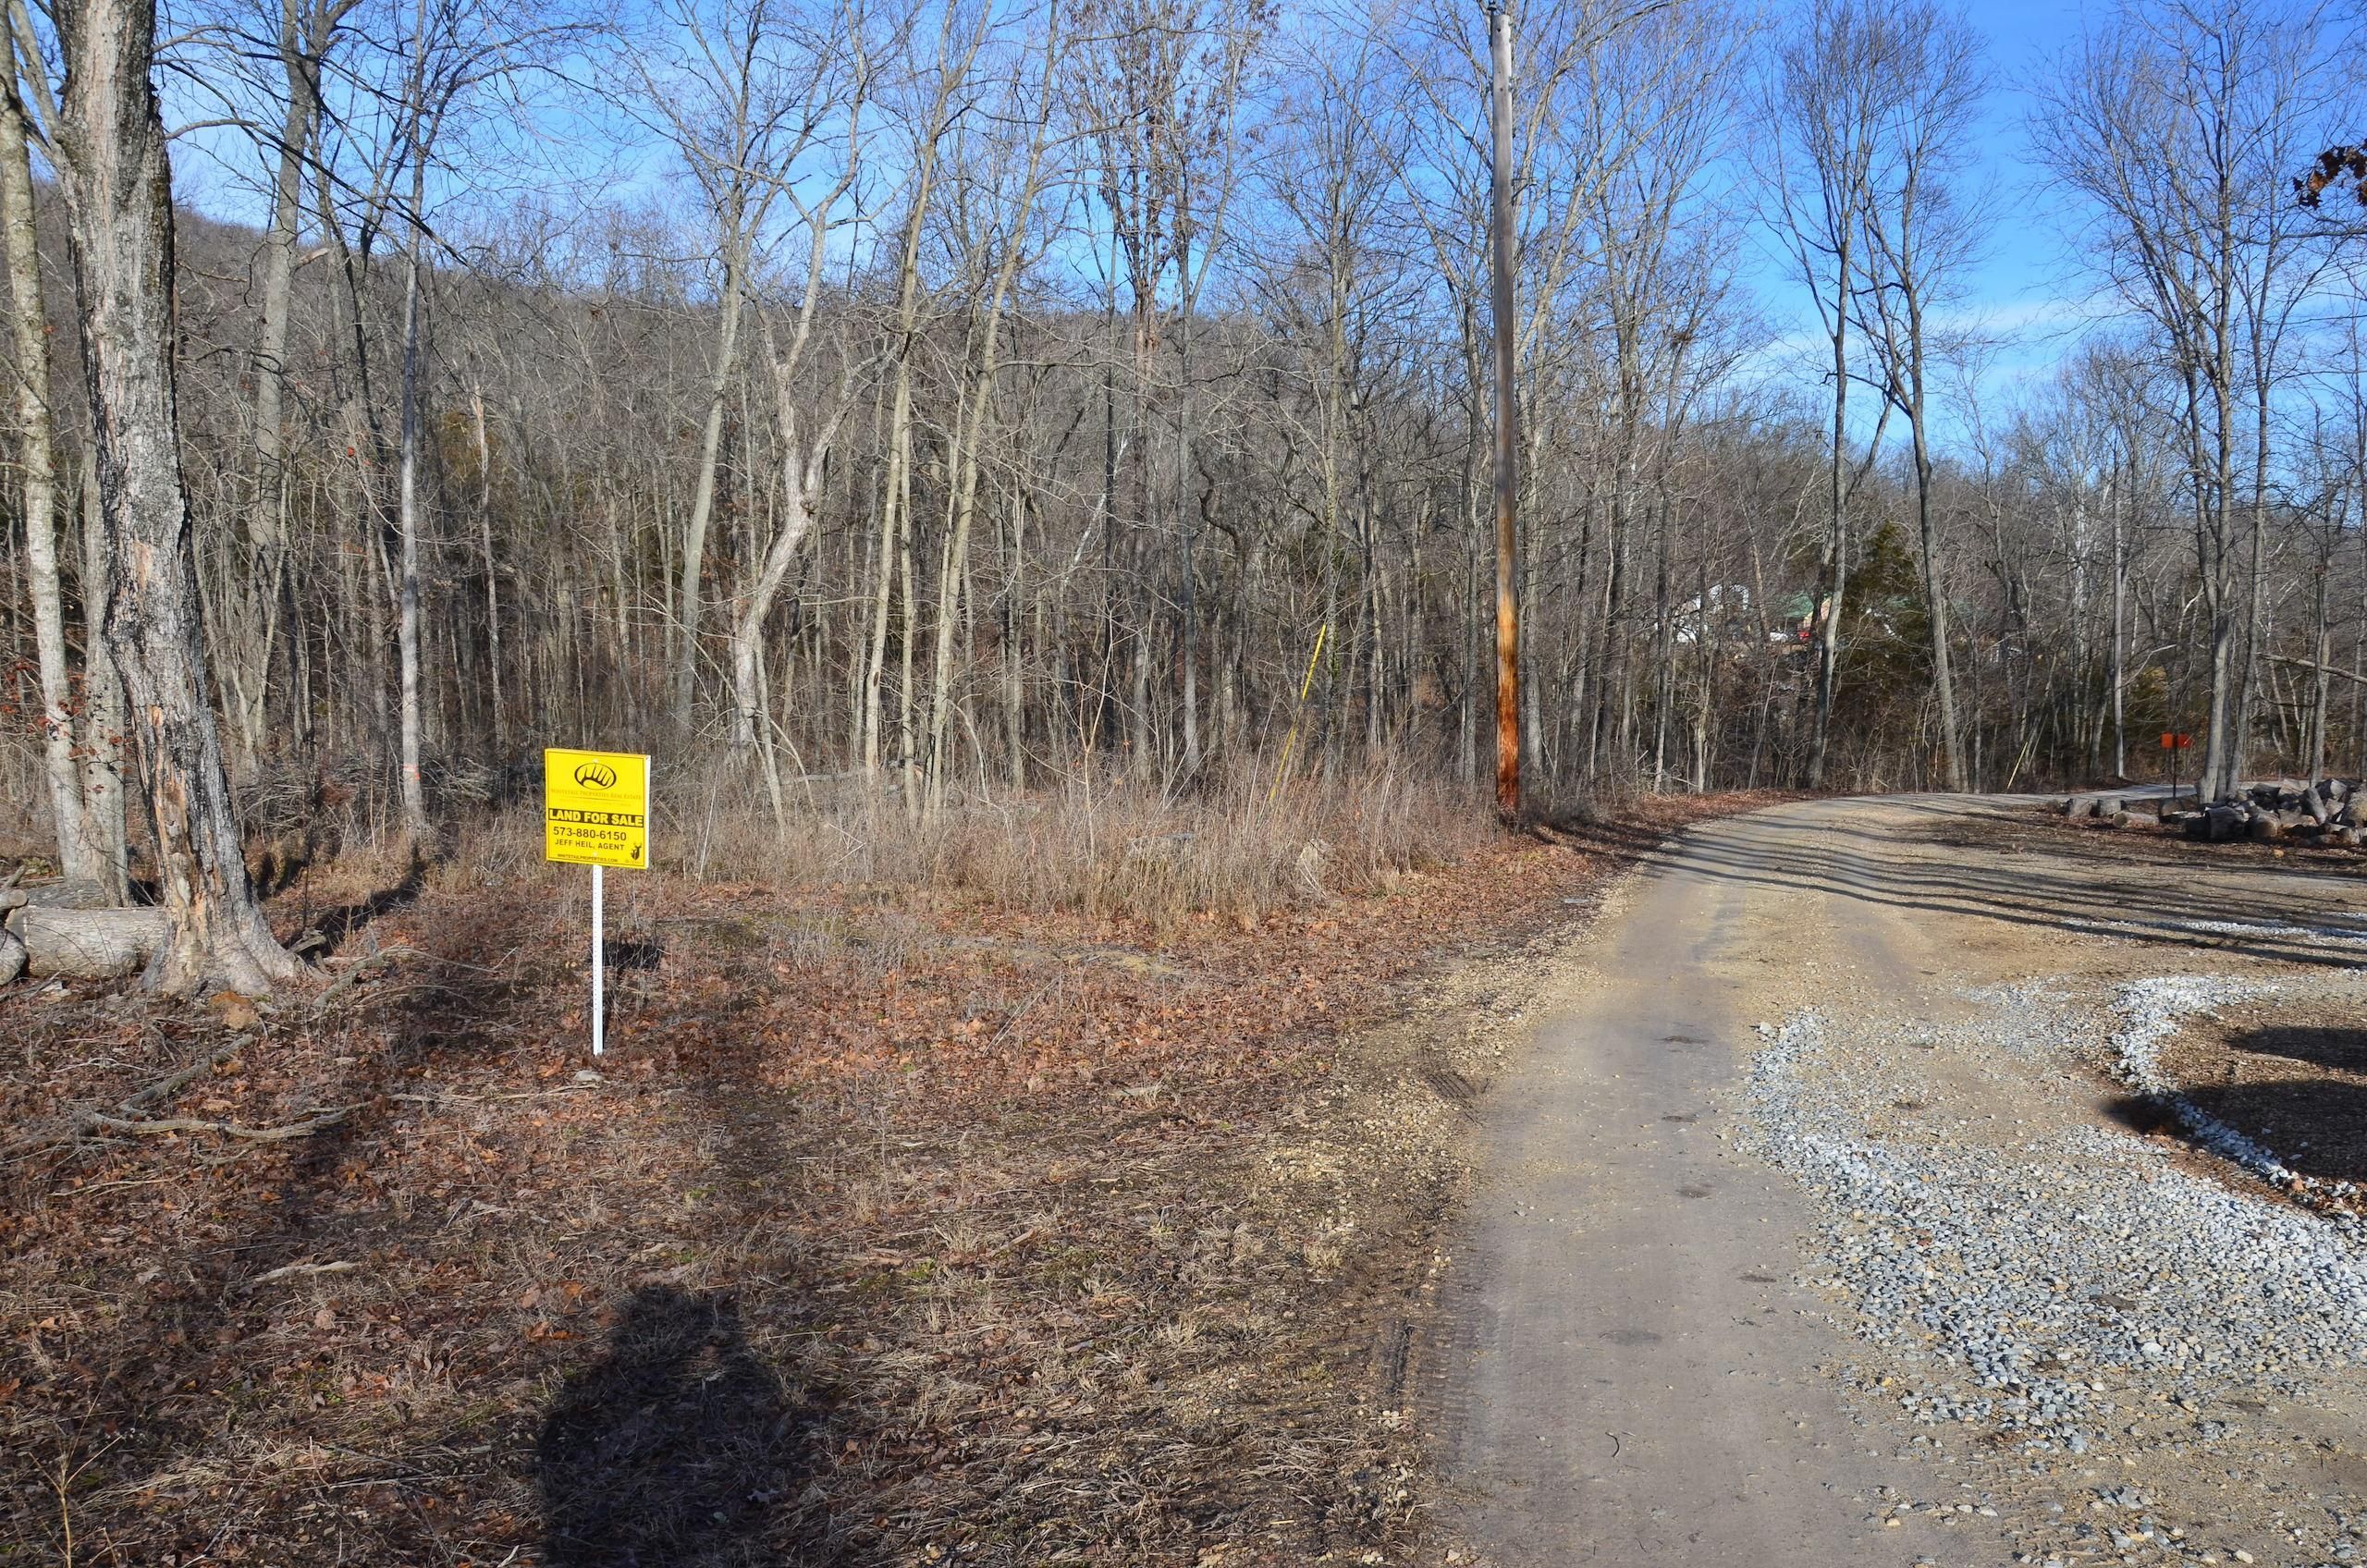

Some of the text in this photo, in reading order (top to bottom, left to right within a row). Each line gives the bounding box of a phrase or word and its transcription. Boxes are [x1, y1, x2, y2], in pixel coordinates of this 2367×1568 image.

[549, 809, 644, 827] LAND FOR SALE
[553, 826, 627, 841] 573-880-6150
[575, 840, 595, 850] HEIL,
[597, 842, 625, 851] AGENT
